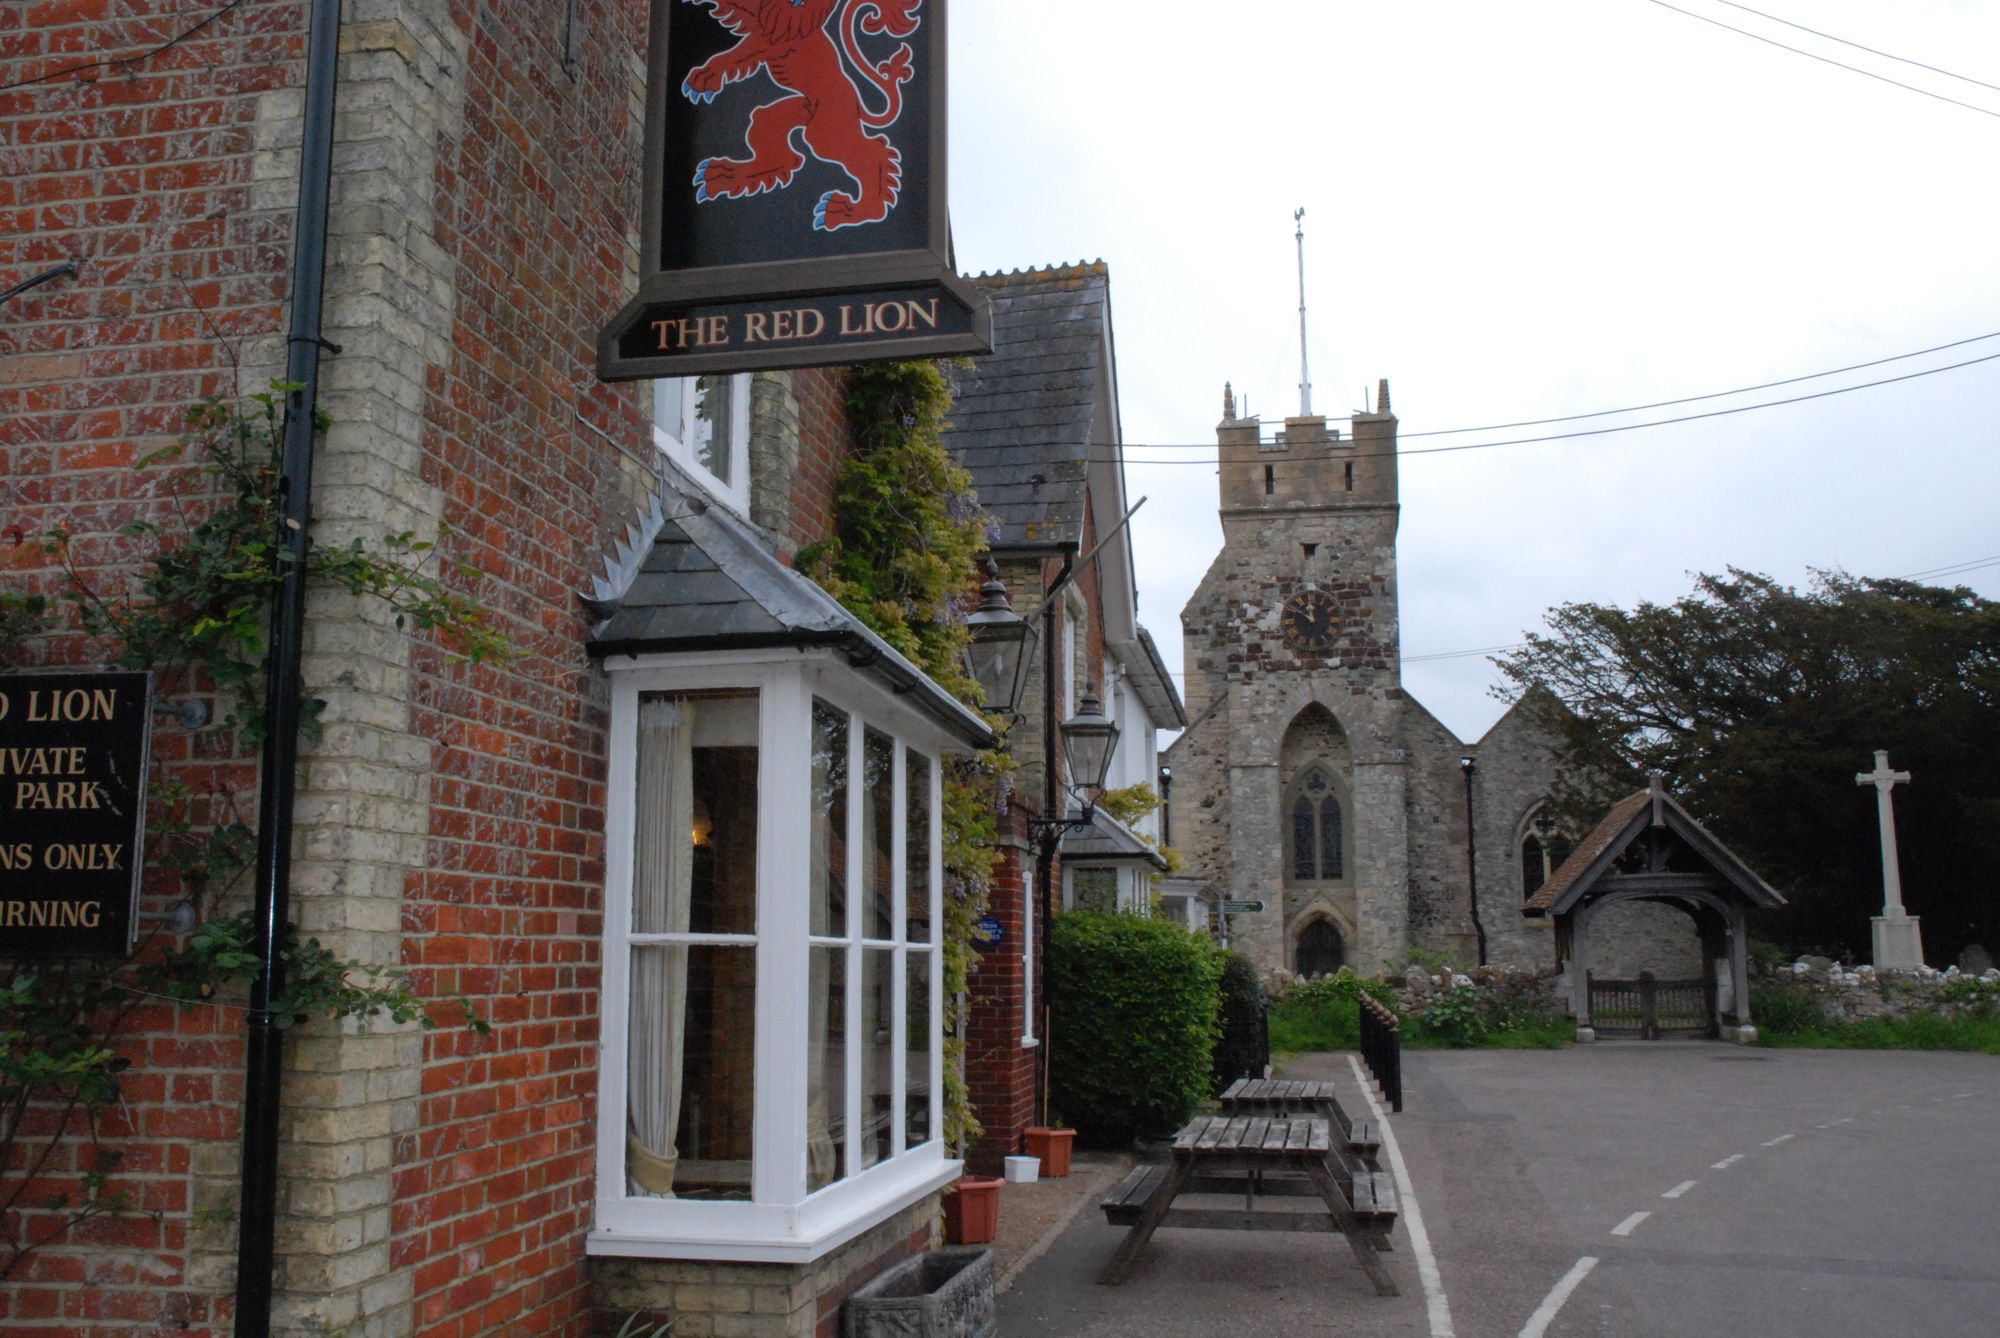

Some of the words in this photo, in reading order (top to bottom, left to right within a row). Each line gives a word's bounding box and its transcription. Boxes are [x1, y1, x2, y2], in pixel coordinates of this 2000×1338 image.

[651, 314, 729, 350] THE
[744, 307, 826, 343] RED
[839, 298, 939, 335] LION
[27, 689, 117, 722] LION
[15, 782, 101, 810] PARK
[44, 843, 122, 870] ONLY
[0, 900, 101, 928] RNING
